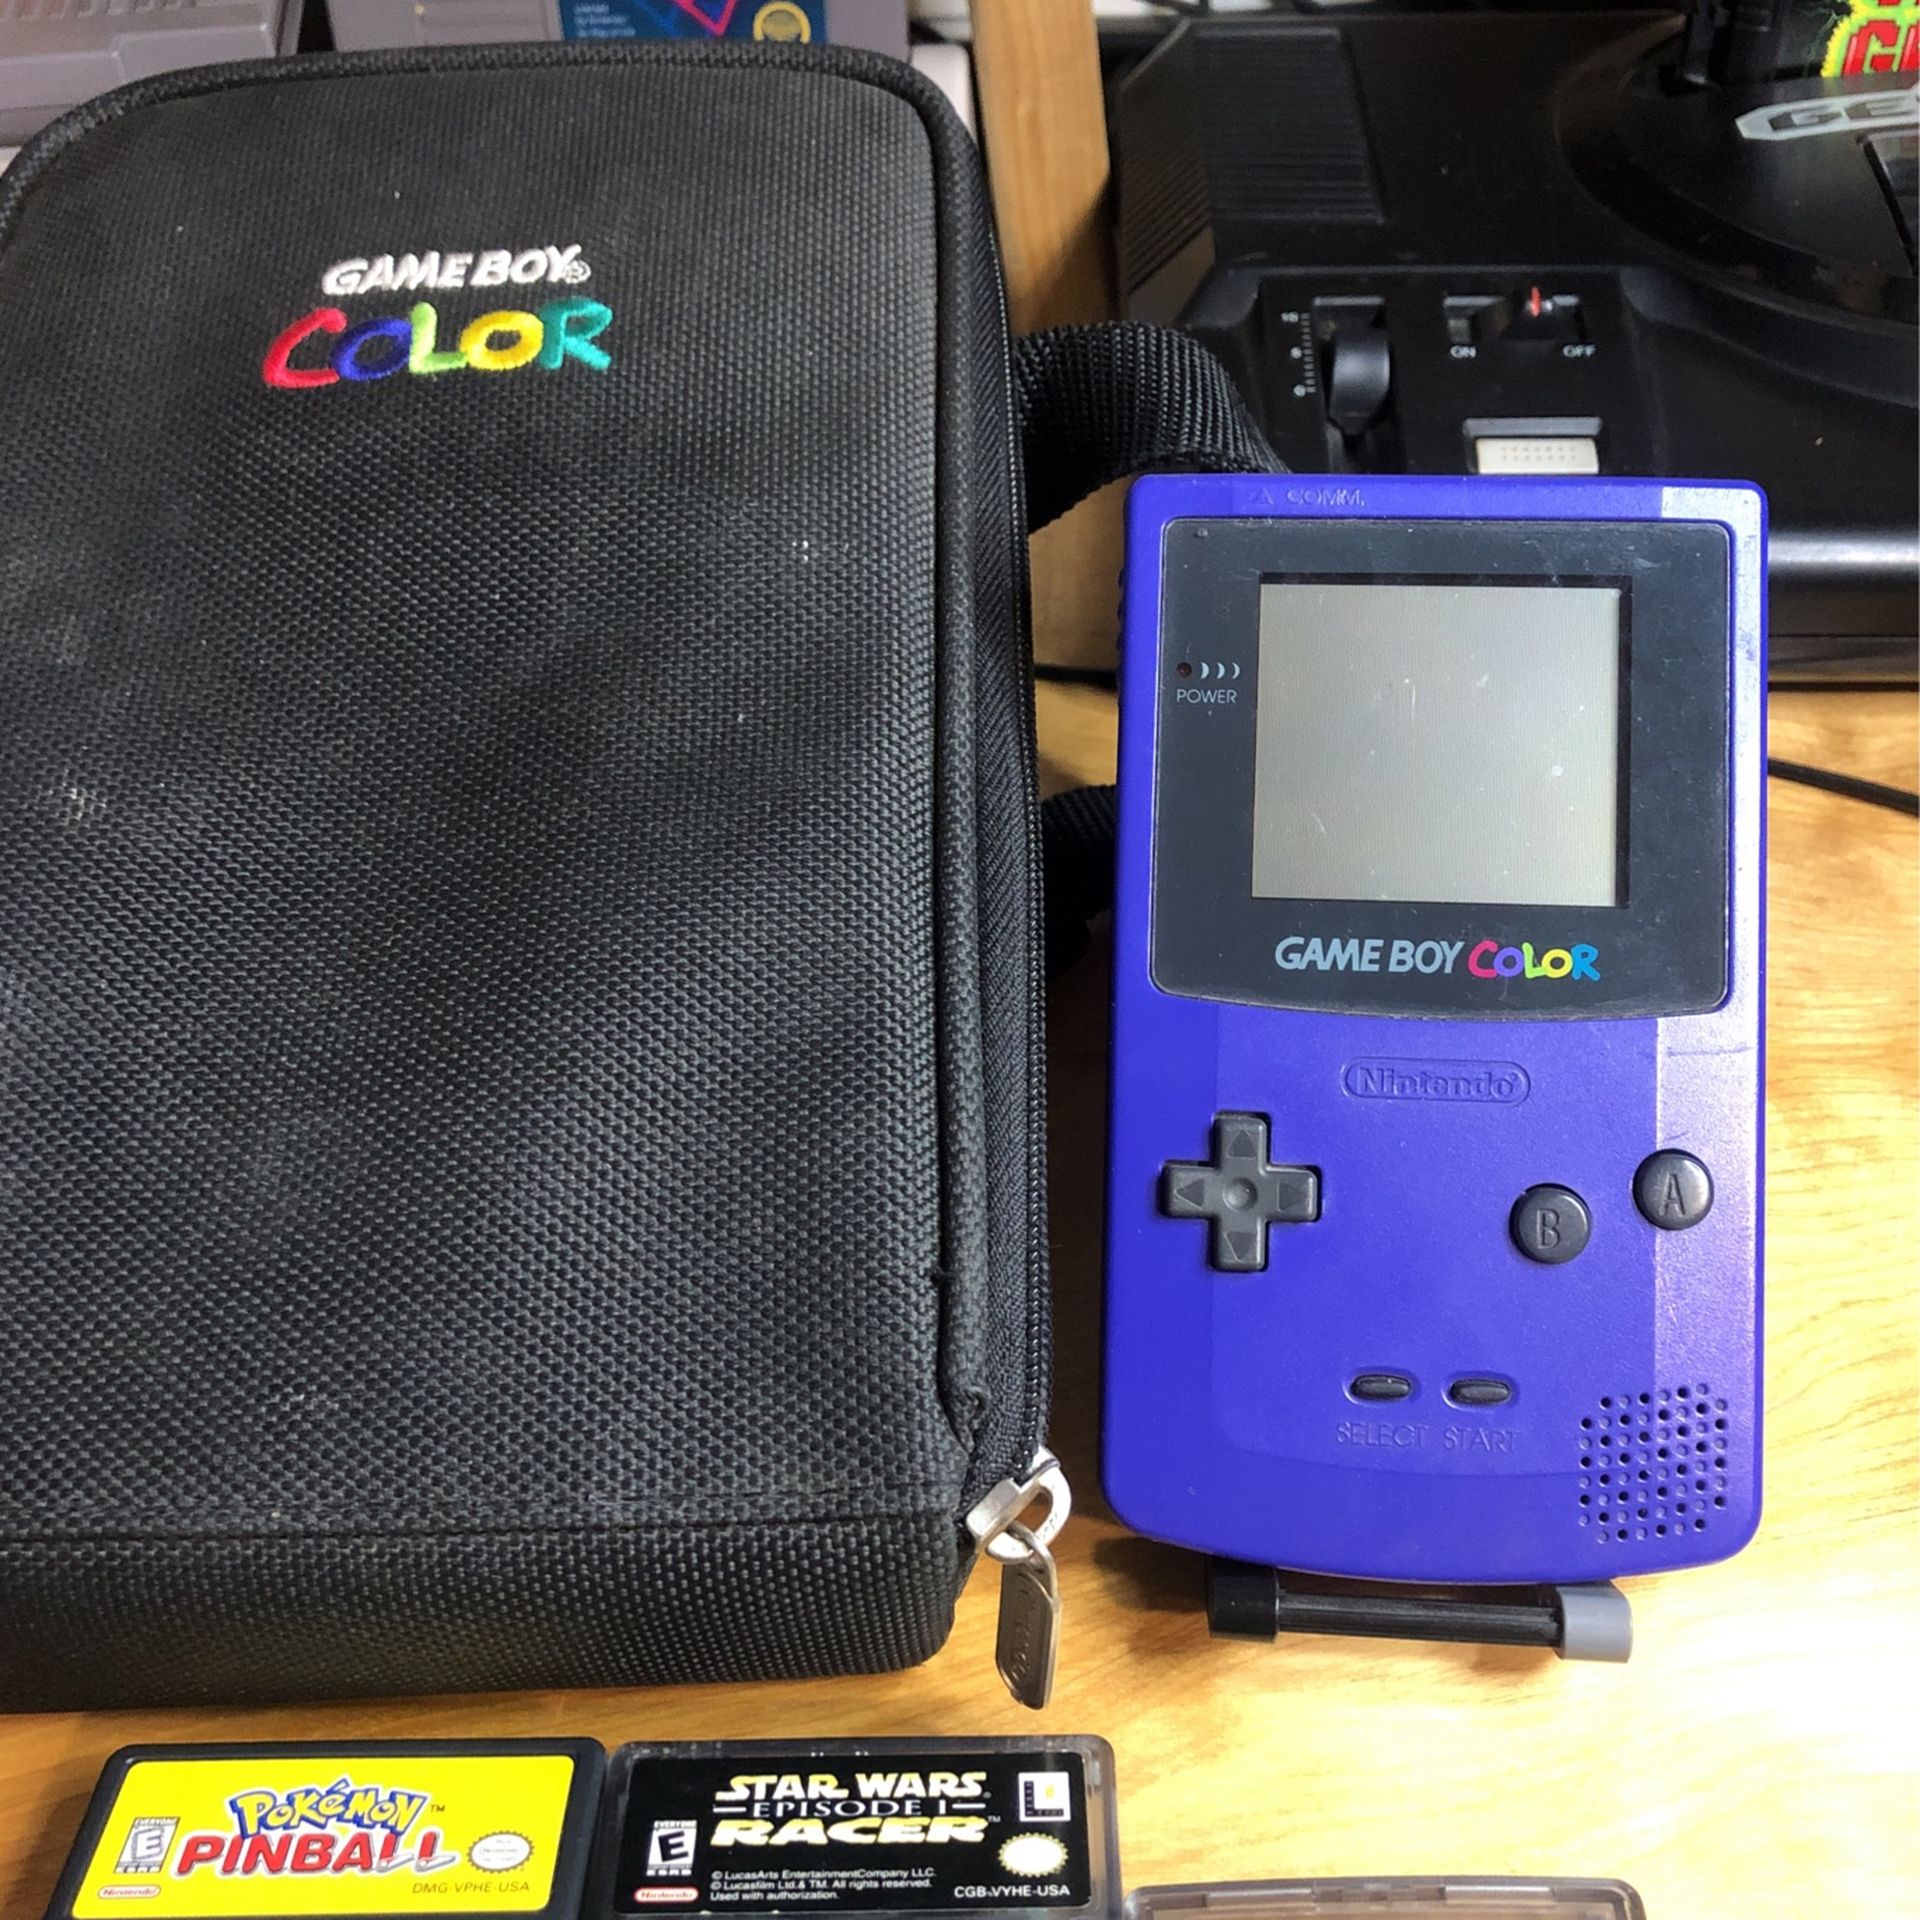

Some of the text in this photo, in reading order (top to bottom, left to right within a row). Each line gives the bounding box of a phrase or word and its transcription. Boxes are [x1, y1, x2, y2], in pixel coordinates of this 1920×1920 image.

[263, 297, 613, 388] COLOR
[1450, 345, 1477, 358] ON
[1562, 345, 1596, 358] OFF
[1176, 688, 1238, 704] POWER
[1275, 936, 1601, 982] GAME BOY COLOR
[1657, 1172, 1687, 1219] A
[1536, 1207, 1561, 1250] B
[1337, 1420, 1521, 1453] SELECT START
[715, 1774, 849, 1801] STAR
[753, 1799, 946, 1818] EPISODE I
[658, 1830, 689, 1862] E
[710, 1816, 989, 1847] RACER
[177, 1831, 456, 1876] PINBALL
[724, 1869, 779, 1880] LucasArts
[832, 1879, 847, 1888] All
[849, 1879, 879, 1891] rights
[709, 1891, 740, 1901] Used
[742, 1891, 765, 1900] with
